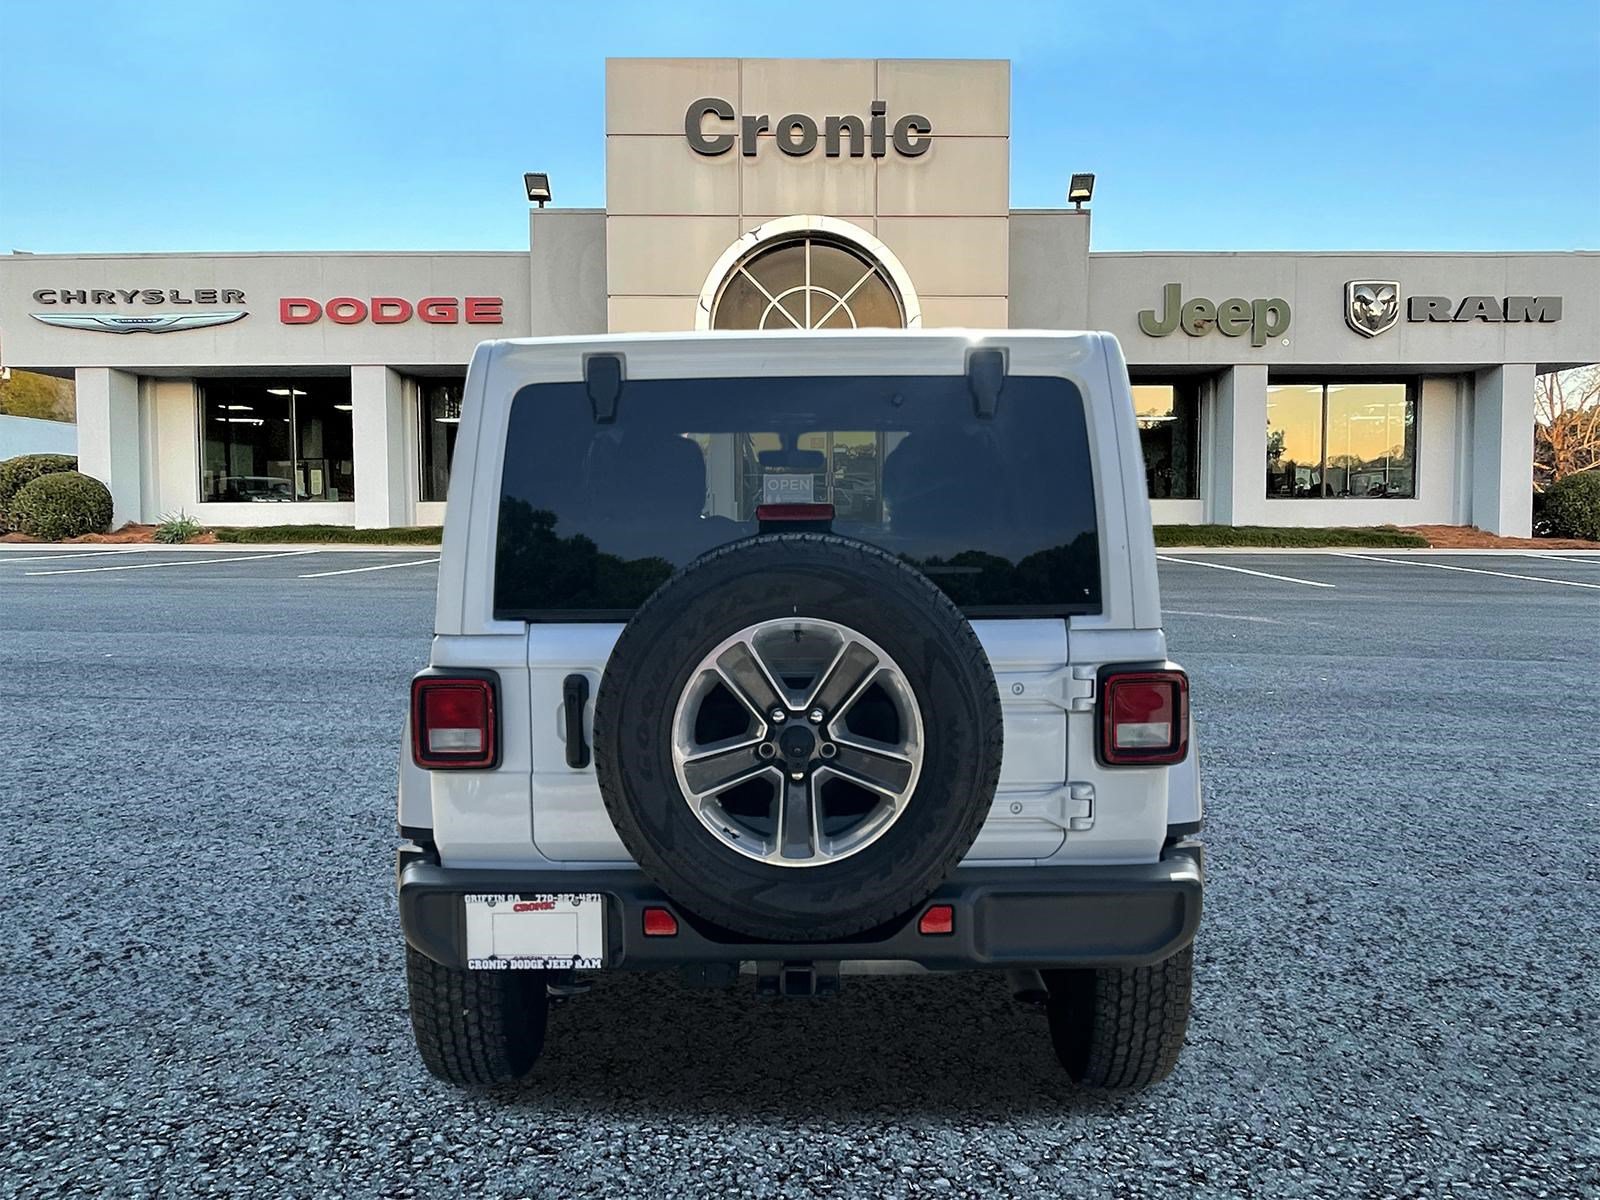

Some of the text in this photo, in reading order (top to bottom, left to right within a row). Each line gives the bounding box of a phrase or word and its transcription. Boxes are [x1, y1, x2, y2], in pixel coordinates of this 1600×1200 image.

[685, 97, 932, 158] Cronic
[32, 289, 247, 305] CHRYSLER
[280, 297, 504, 324] DODGE
[1138, 283, 1291, 347] Jeep
[1407, 296, 1563, 323] RAM
[767, 479, 810, 491] OPEN
[464, 894, 505, 903] GRIFFIN
[513, 901, 556, 912] CRONIC
[468, 958, 602, 969] CRONIC DODGE JEEP RAM
